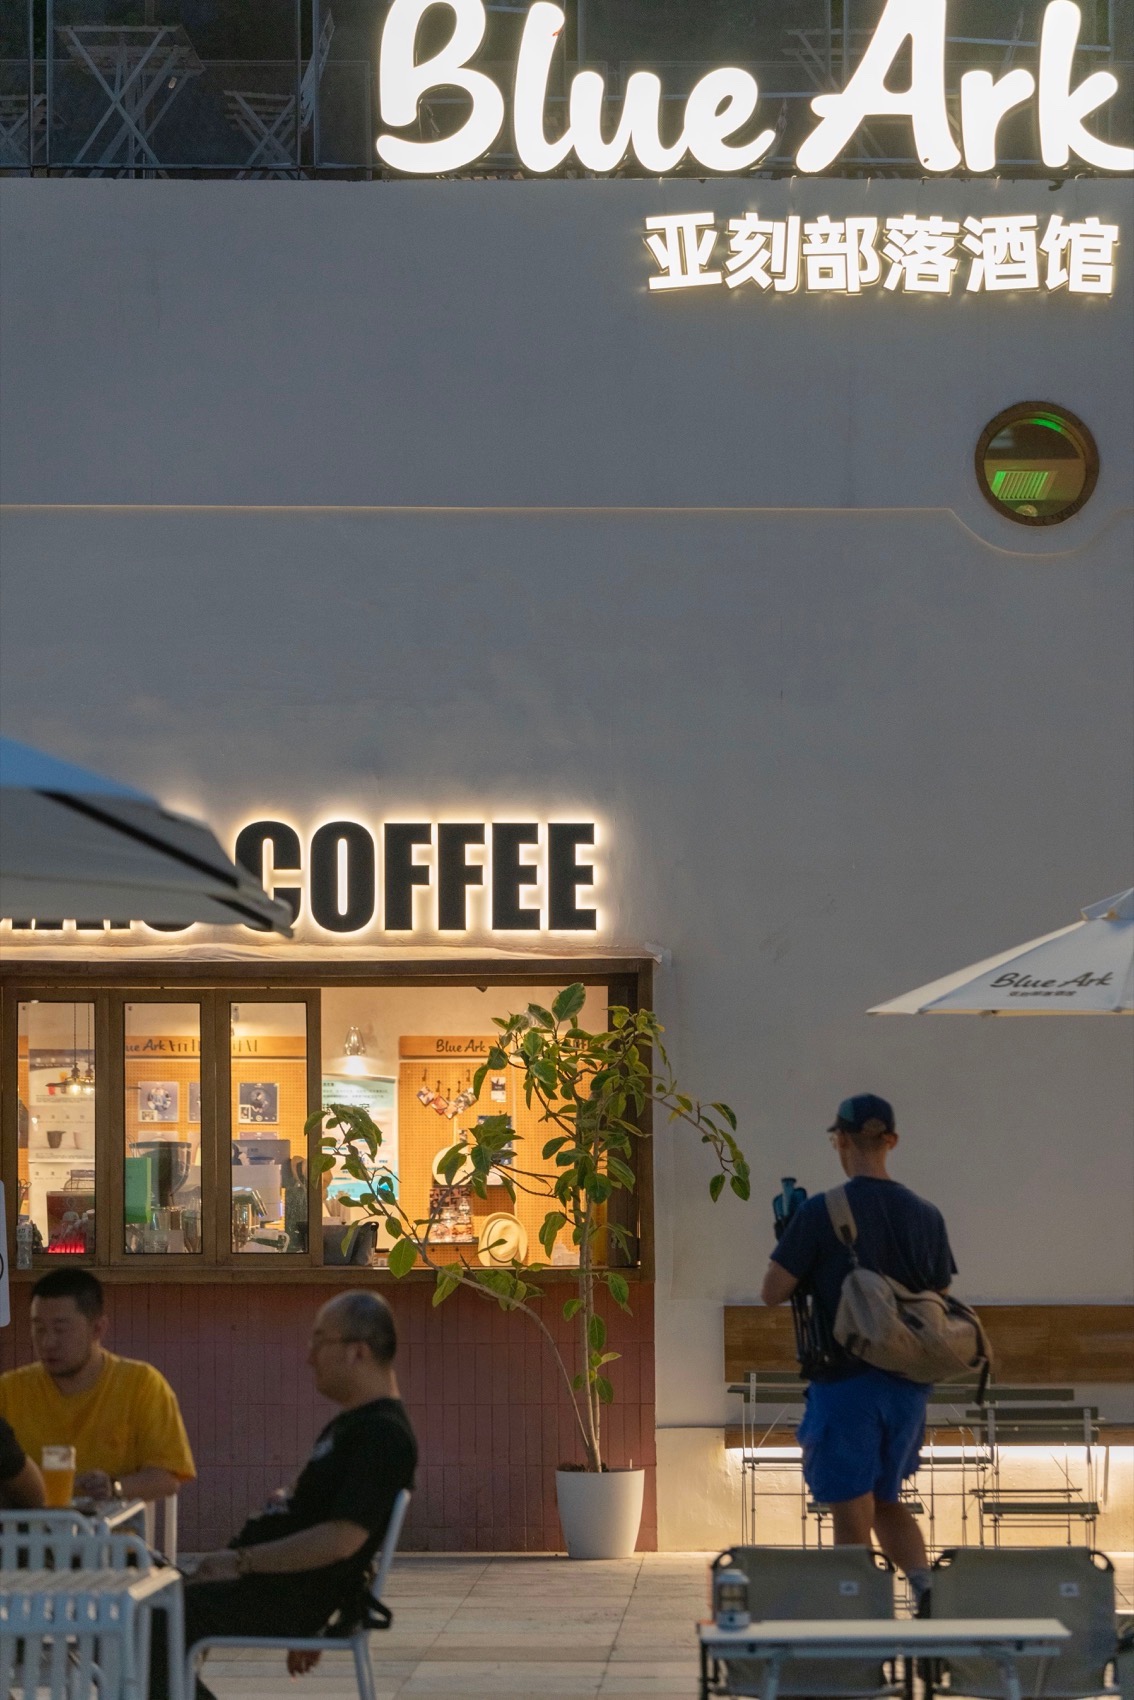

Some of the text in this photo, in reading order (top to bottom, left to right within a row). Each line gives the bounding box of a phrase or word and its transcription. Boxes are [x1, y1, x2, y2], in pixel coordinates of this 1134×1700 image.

[376, 0, 1134, 173] Blue Ark
[644, 211, 1119, 296] 亚刻部落酒馆
[235, 820, 597, 932] COFFEE
[990, 971, 1114, 988] Blue Ark
[143, 1038, 166, 1052] Ark
[435, 1039, 486, 1053] Blue Ark
